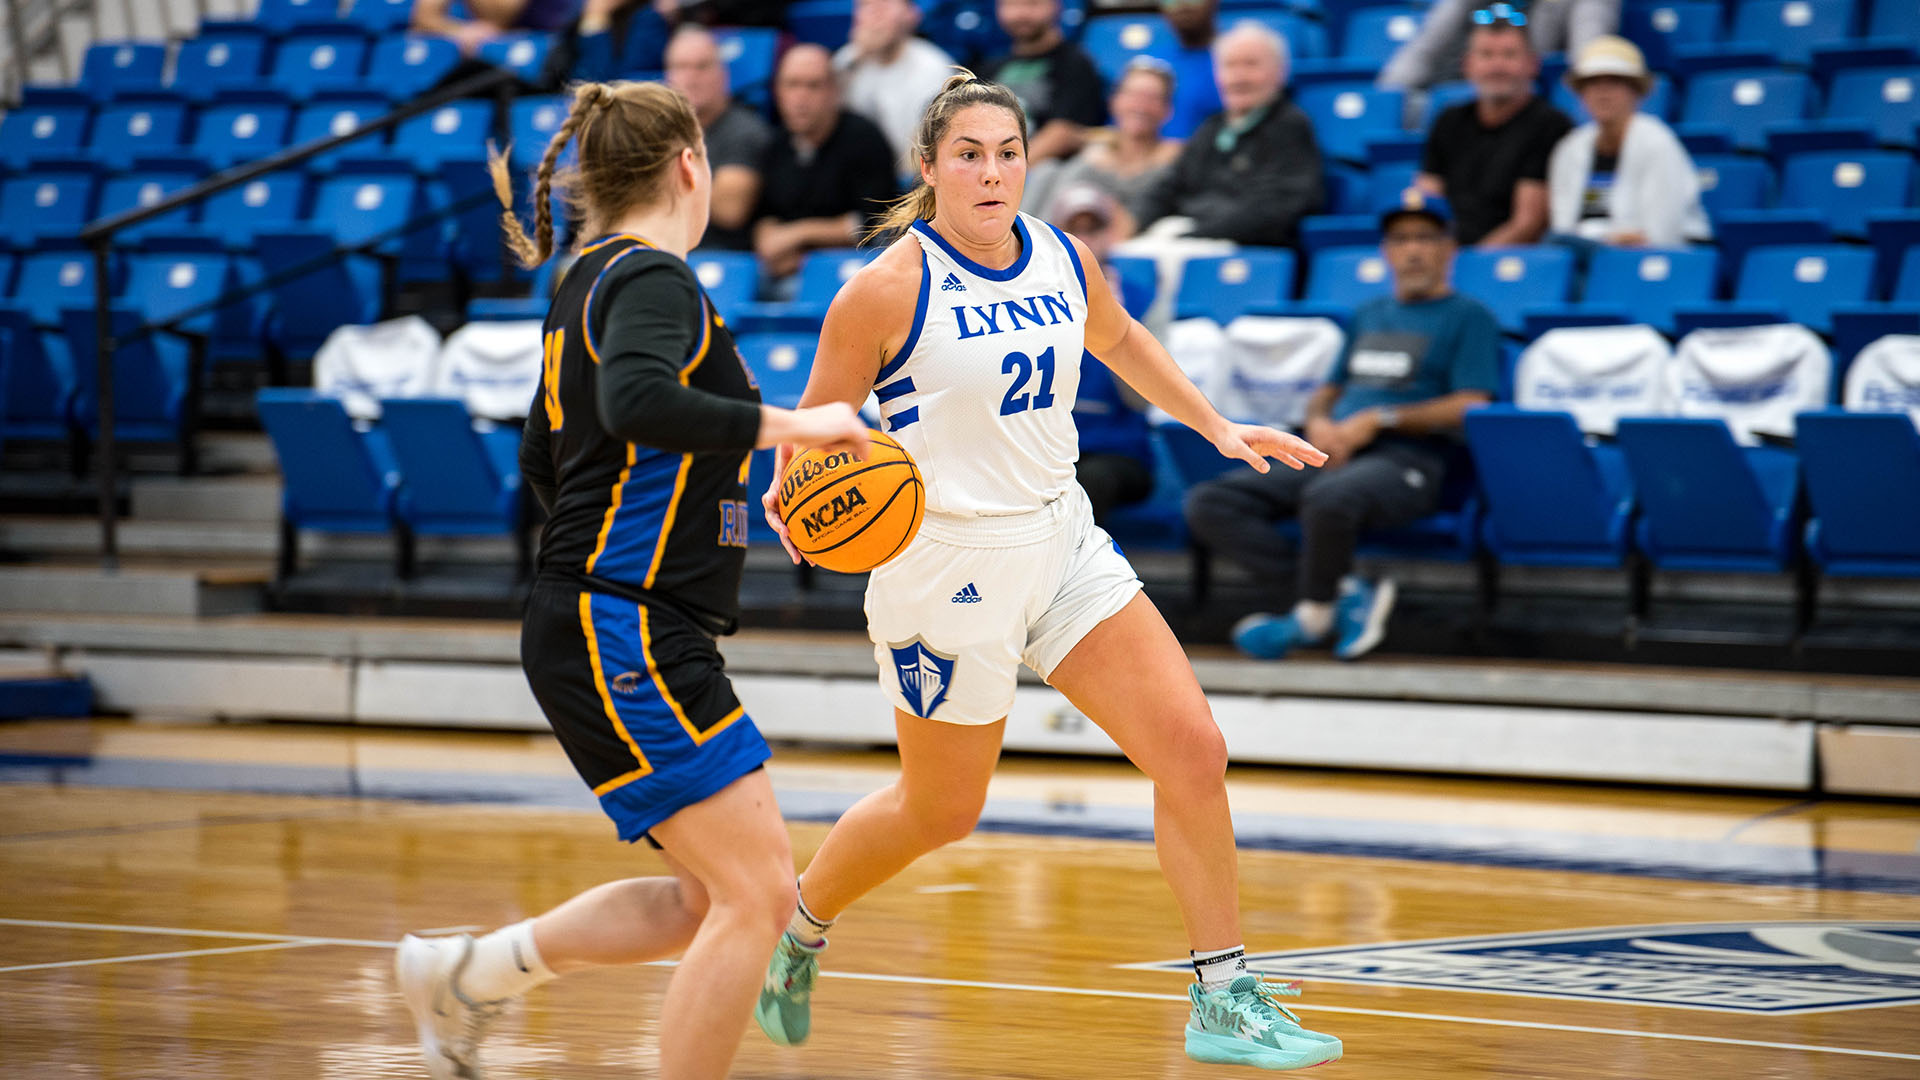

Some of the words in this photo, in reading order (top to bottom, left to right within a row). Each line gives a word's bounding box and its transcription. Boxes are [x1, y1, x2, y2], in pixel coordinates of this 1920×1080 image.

[951, 291, 1074, 340] LYNN
[1000, 346, 1055, 416] 21
[780, 451, 863, 507] Wilson
[801, 486, 867, 538] NCAA
[951, 595, 982, 603] adidas
